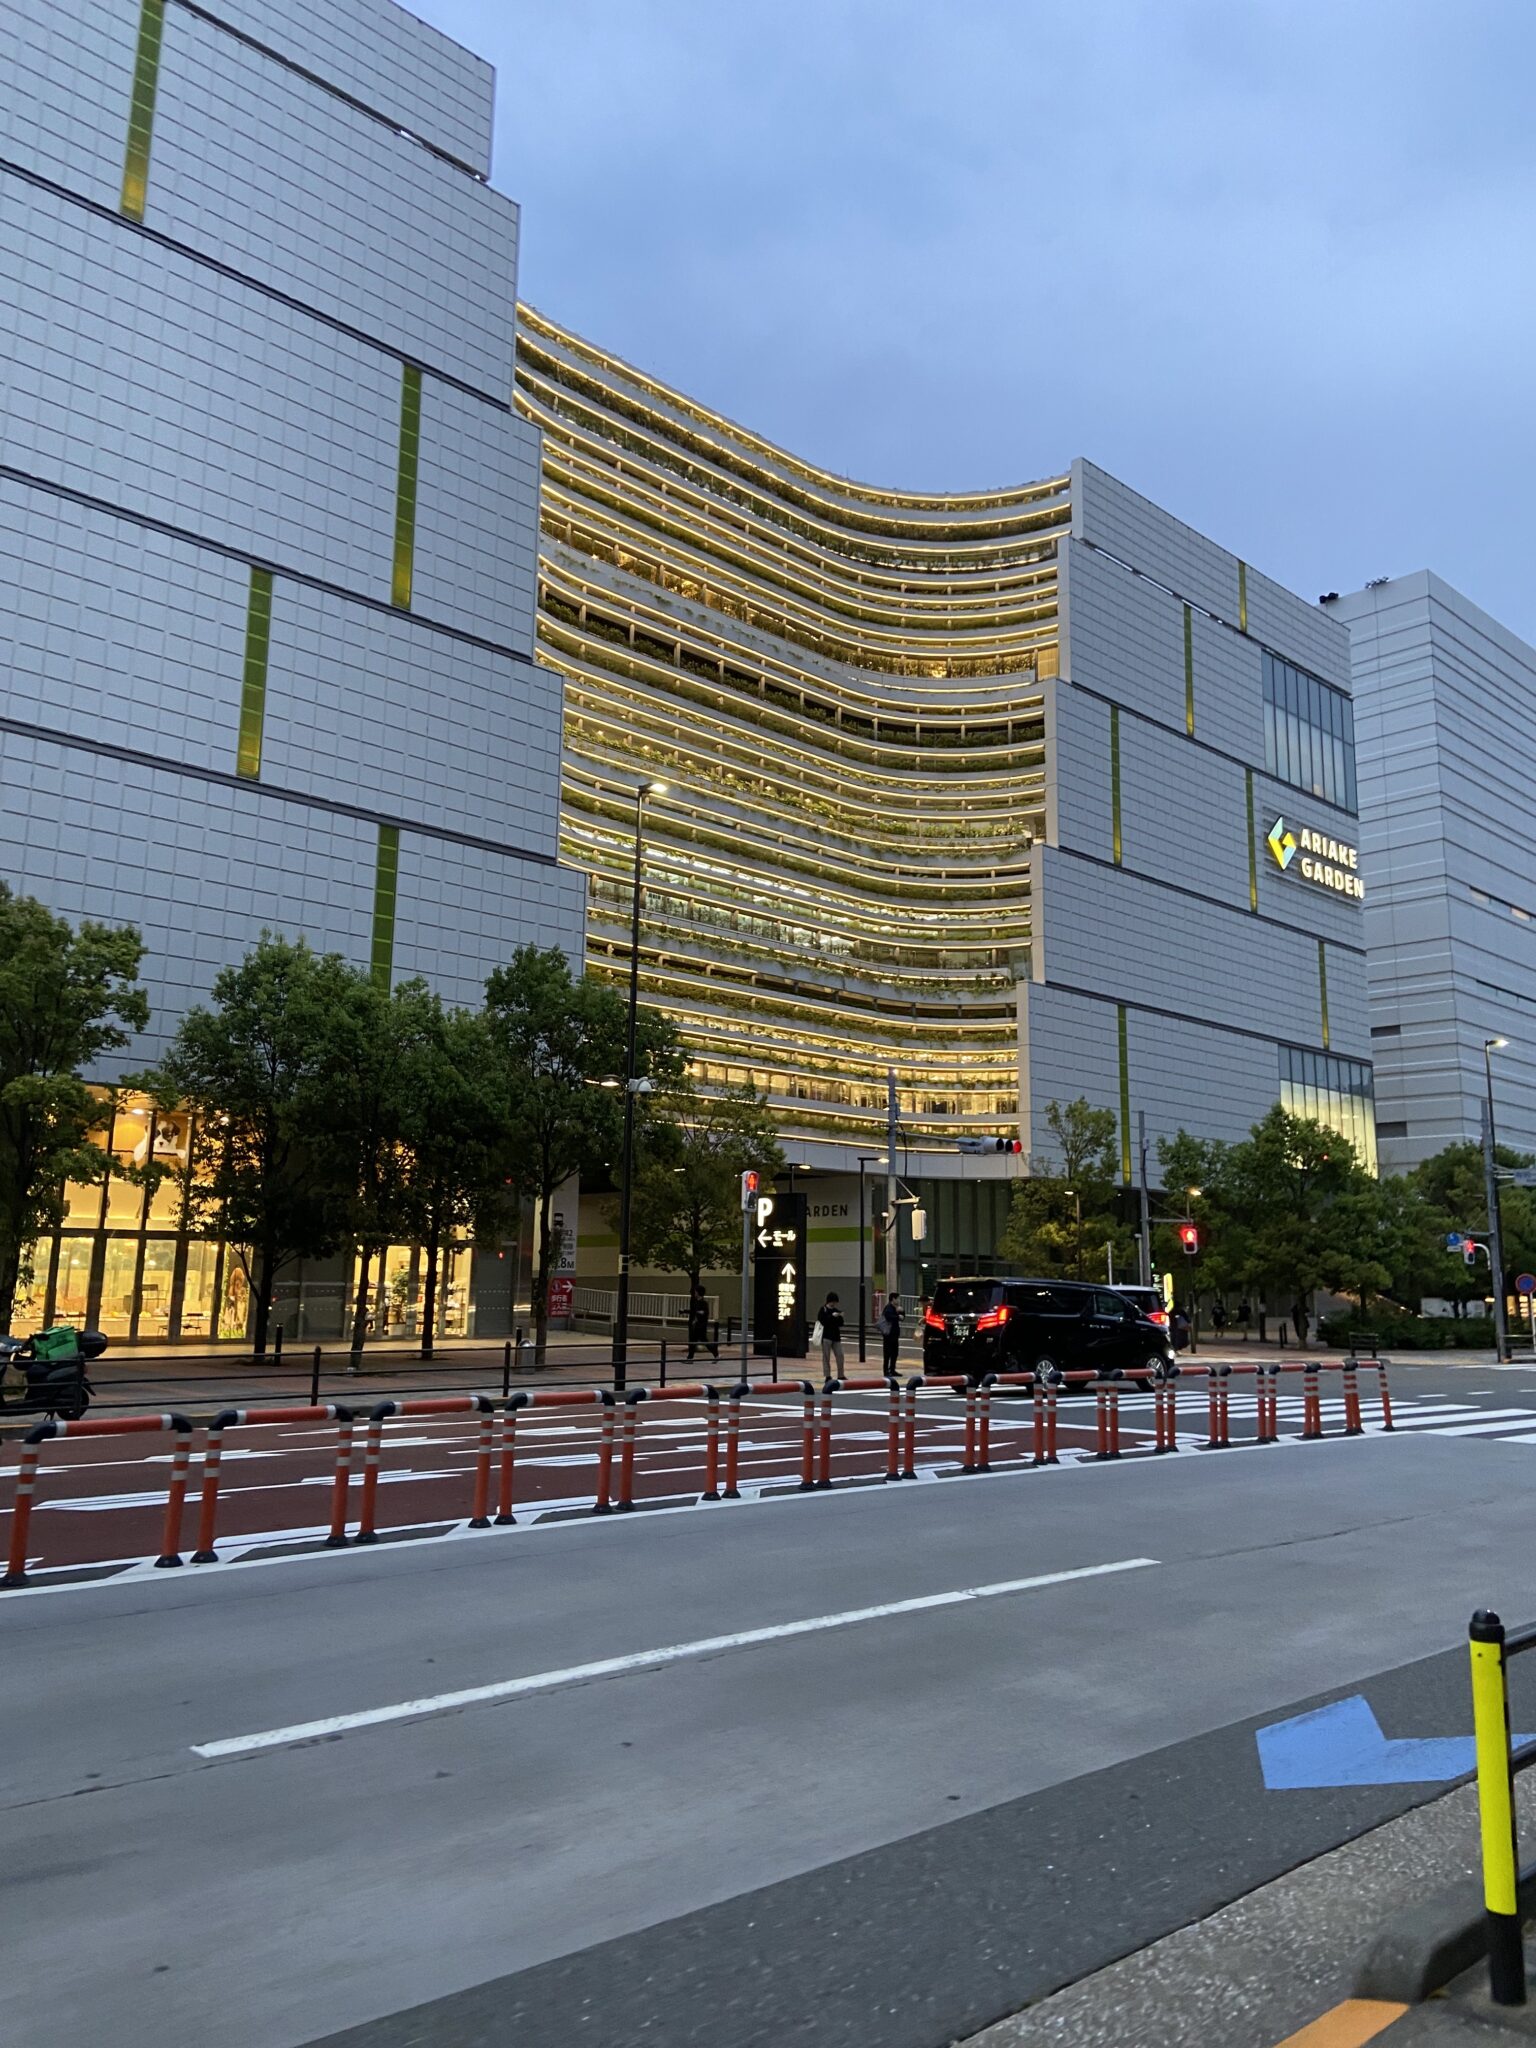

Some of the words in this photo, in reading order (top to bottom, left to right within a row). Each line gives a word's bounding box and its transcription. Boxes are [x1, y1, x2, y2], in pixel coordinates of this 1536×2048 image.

[1300, 828, 1358, 870] ARIAKE
[1301, 857, 1365, 899] GARDEN
[757, 1197, 773, 1227] P
